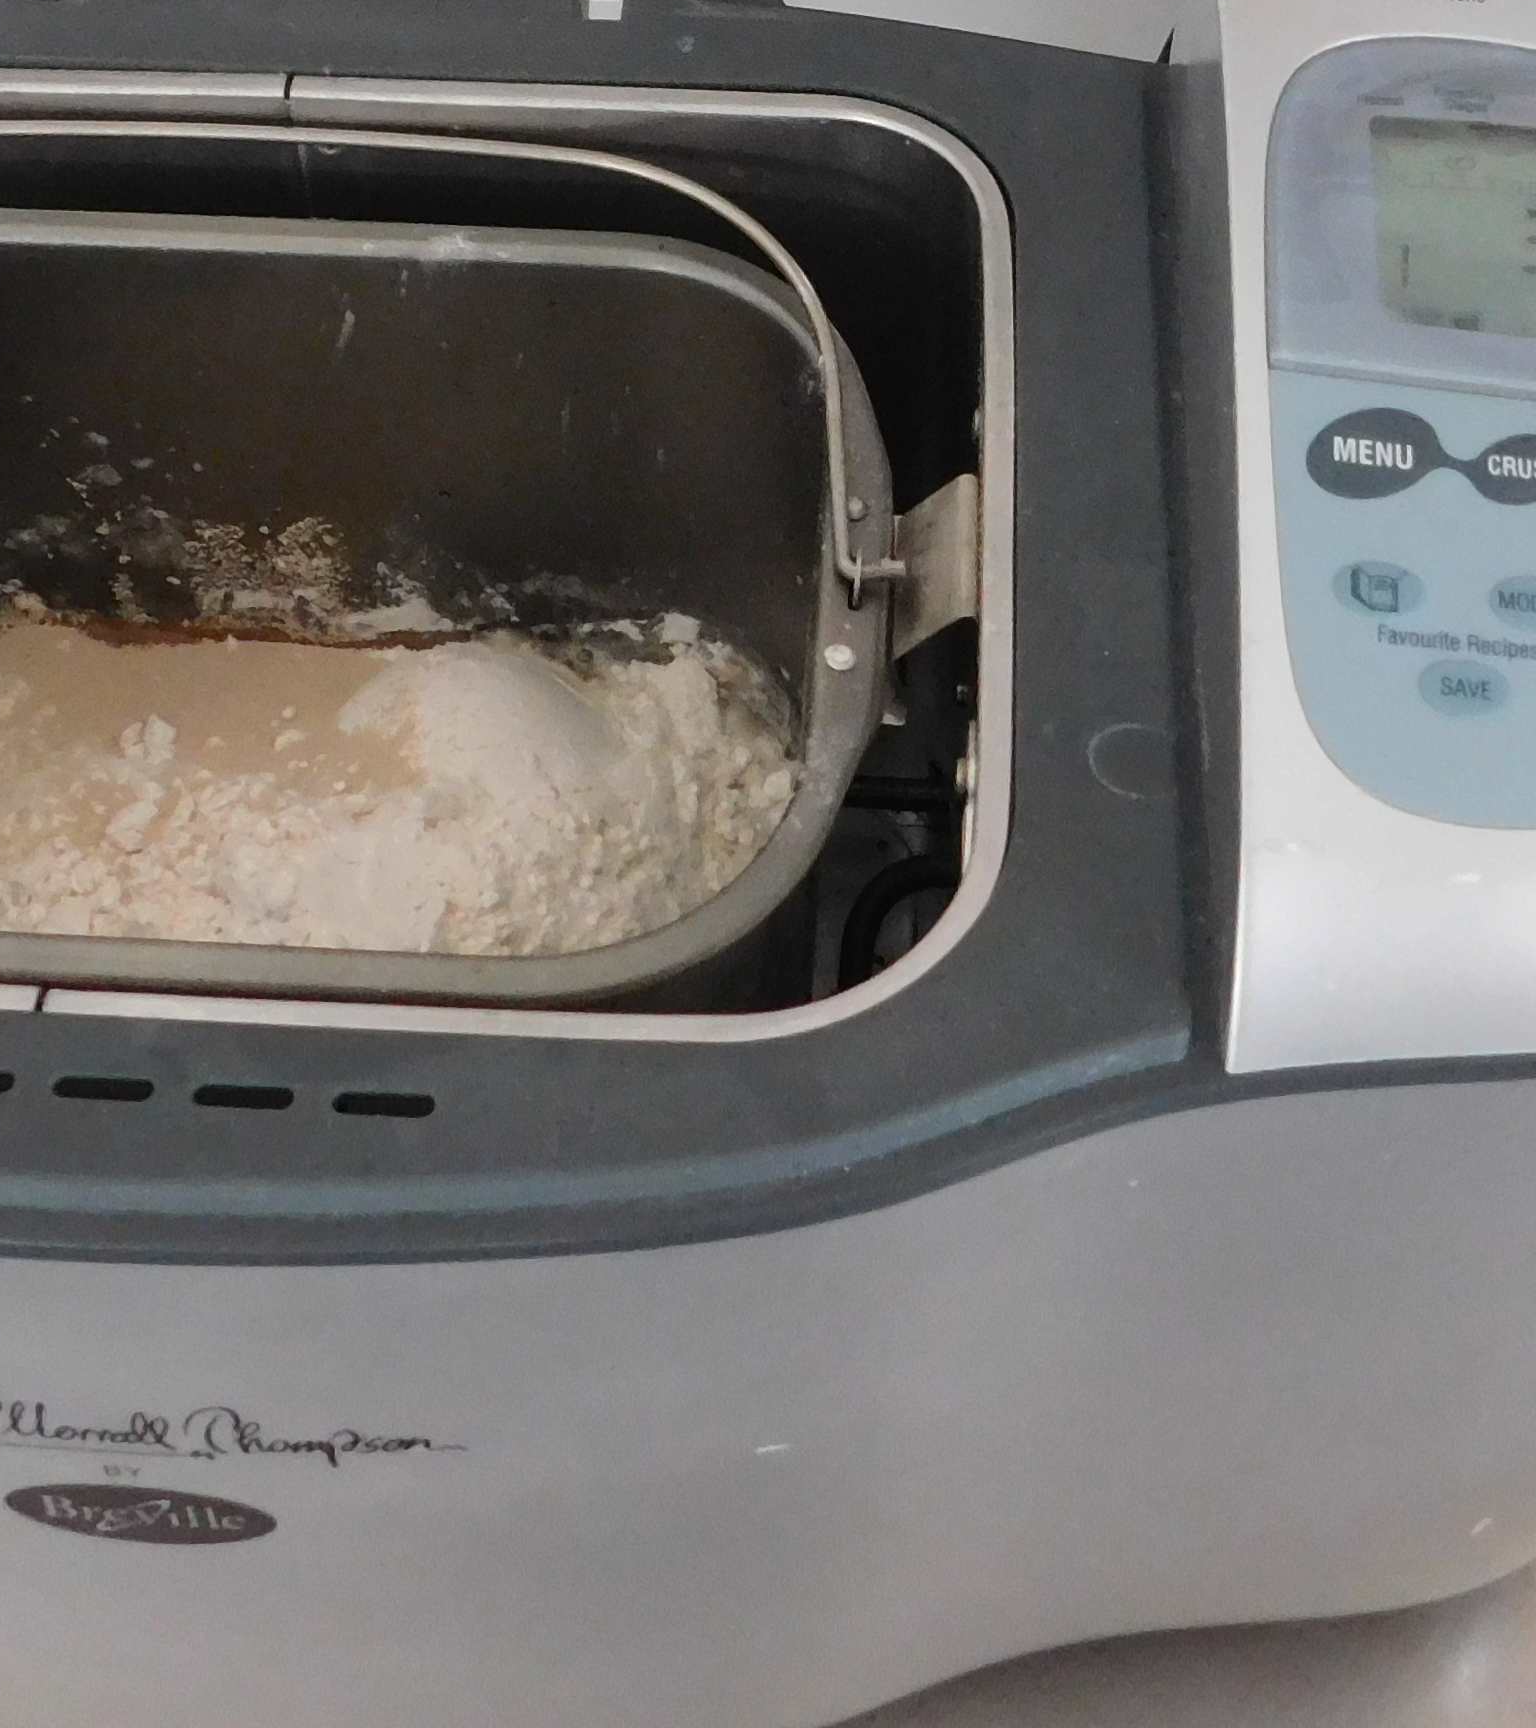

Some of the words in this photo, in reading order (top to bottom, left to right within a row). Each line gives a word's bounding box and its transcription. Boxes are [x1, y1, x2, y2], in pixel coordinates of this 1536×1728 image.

[1332, 436, 1414, 471] MENU
[1376, 623, 1462, 653] Favourite
[1439, 676, 1492, 702] SAVE
